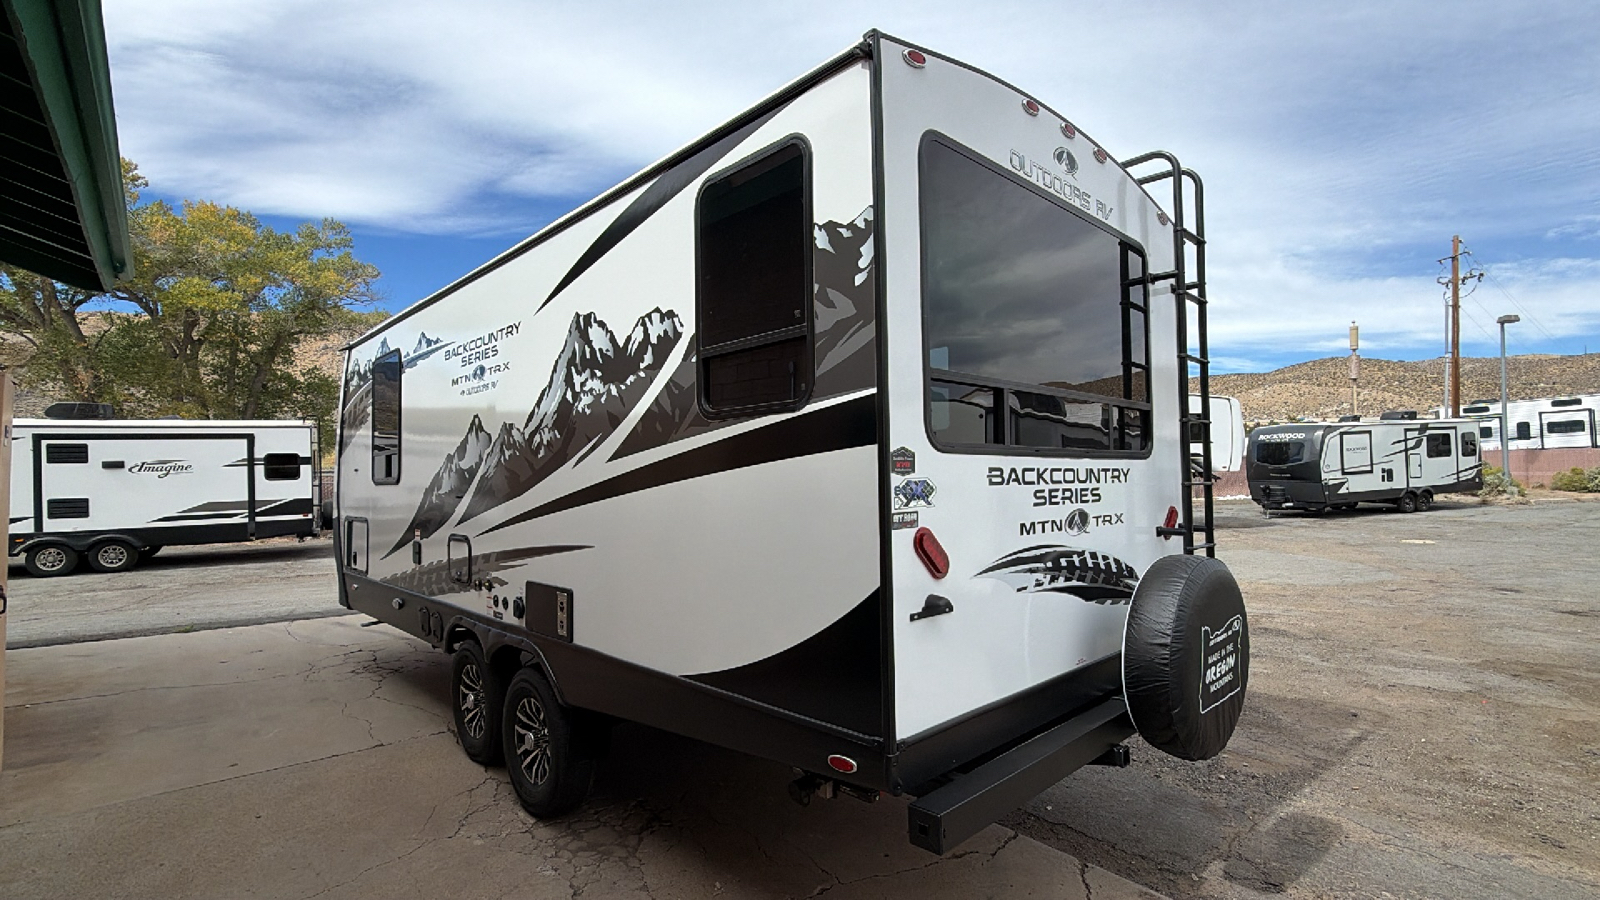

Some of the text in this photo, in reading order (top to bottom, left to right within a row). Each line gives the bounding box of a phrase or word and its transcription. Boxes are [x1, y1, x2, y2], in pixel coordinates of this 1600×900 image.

[1010, 148, 1113, 220] OUTDOORS RV
[443, 321, 521, 361] BACKCOUNTRY
[461, 345, 499, 368] SERIES
[451, 362, 510, 387] MTN TRX
[128, 461, 193, 478] Imagine
[987, 467, 1130, 486] BACKCOUNTRY
[1033, 487, 1102, 507] SERIES
[1019, 513, 1124, 536] MTN TRX
[1205, 653, 1236, 684] OREGON
